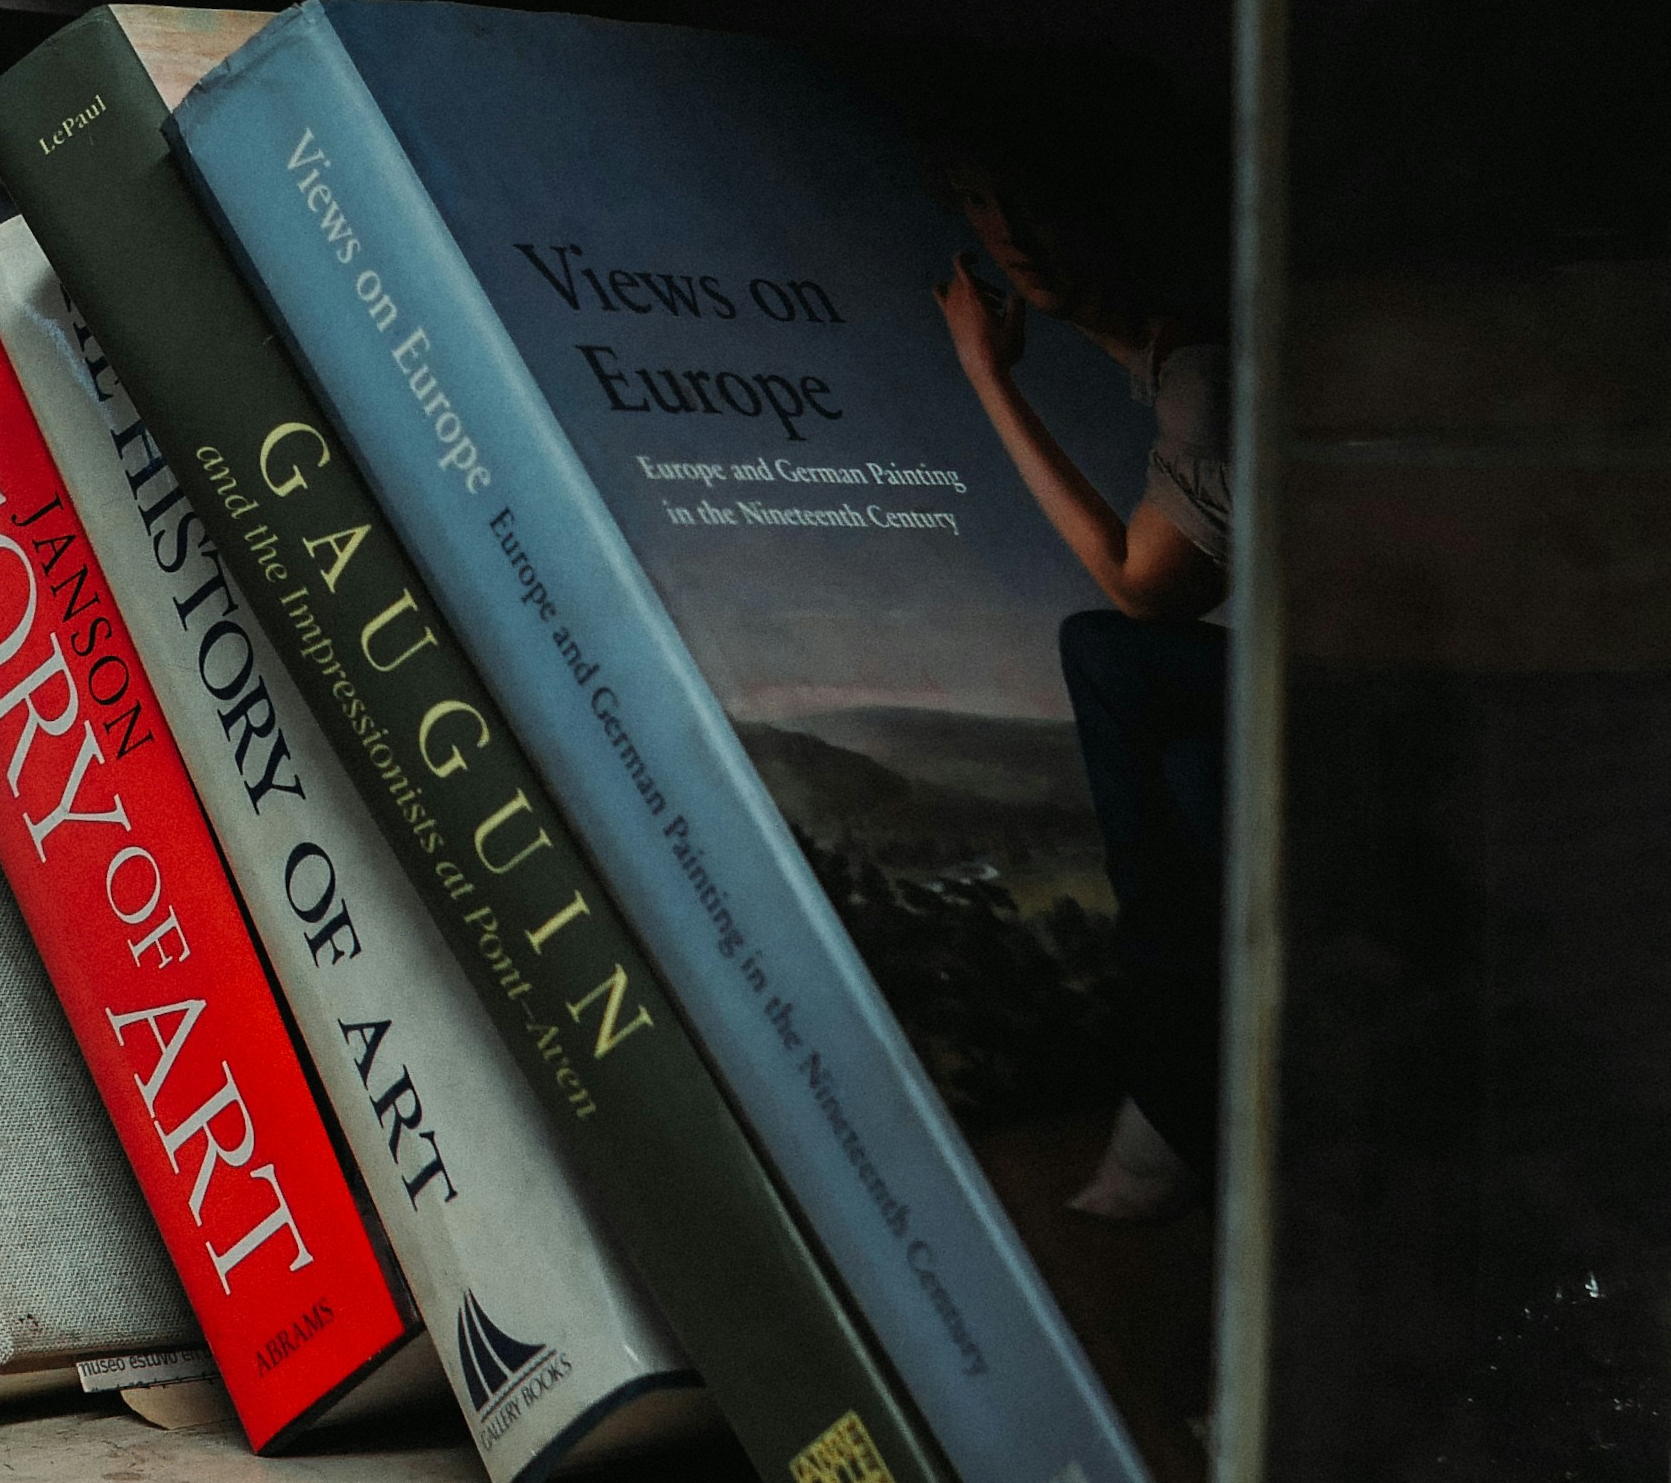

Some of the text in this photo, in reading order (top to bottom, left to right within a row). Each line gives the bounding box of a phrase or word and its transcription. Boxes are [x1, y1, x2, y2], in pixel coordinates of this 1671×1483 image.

[38, 95, 109, 158] LePaul
[285, 127, 491, 494] Views on Europe
[513, 243, 847, 324] Views on
[574, 344, 843, 442] Europe
[636, 455, 967, 494] Europe and German Painting
[663, 501, 960, 537] in the Nineteenth Century
[10, 496, 154, 761] JANSON
[195, 443, 260, 521] and
[243, 518, 291, 586] the
[279, 584, 444, 855] Impressionists
[436, 858, 476, 902] at
[258, 421, 655, 1060] GAUGUIN
[110, 413, 457, 1212] HISTORY OF ART
[104, 845, 192, 970] OF
[488, 507, 987, 1378] Europe and German Painting in the Nineteenth Century
[104, 998, 316, 1296] ART
[253, 1295, 334, 1377] ABRAMS
[479, 1356, 573, 1452] GALLERY BOOKS
